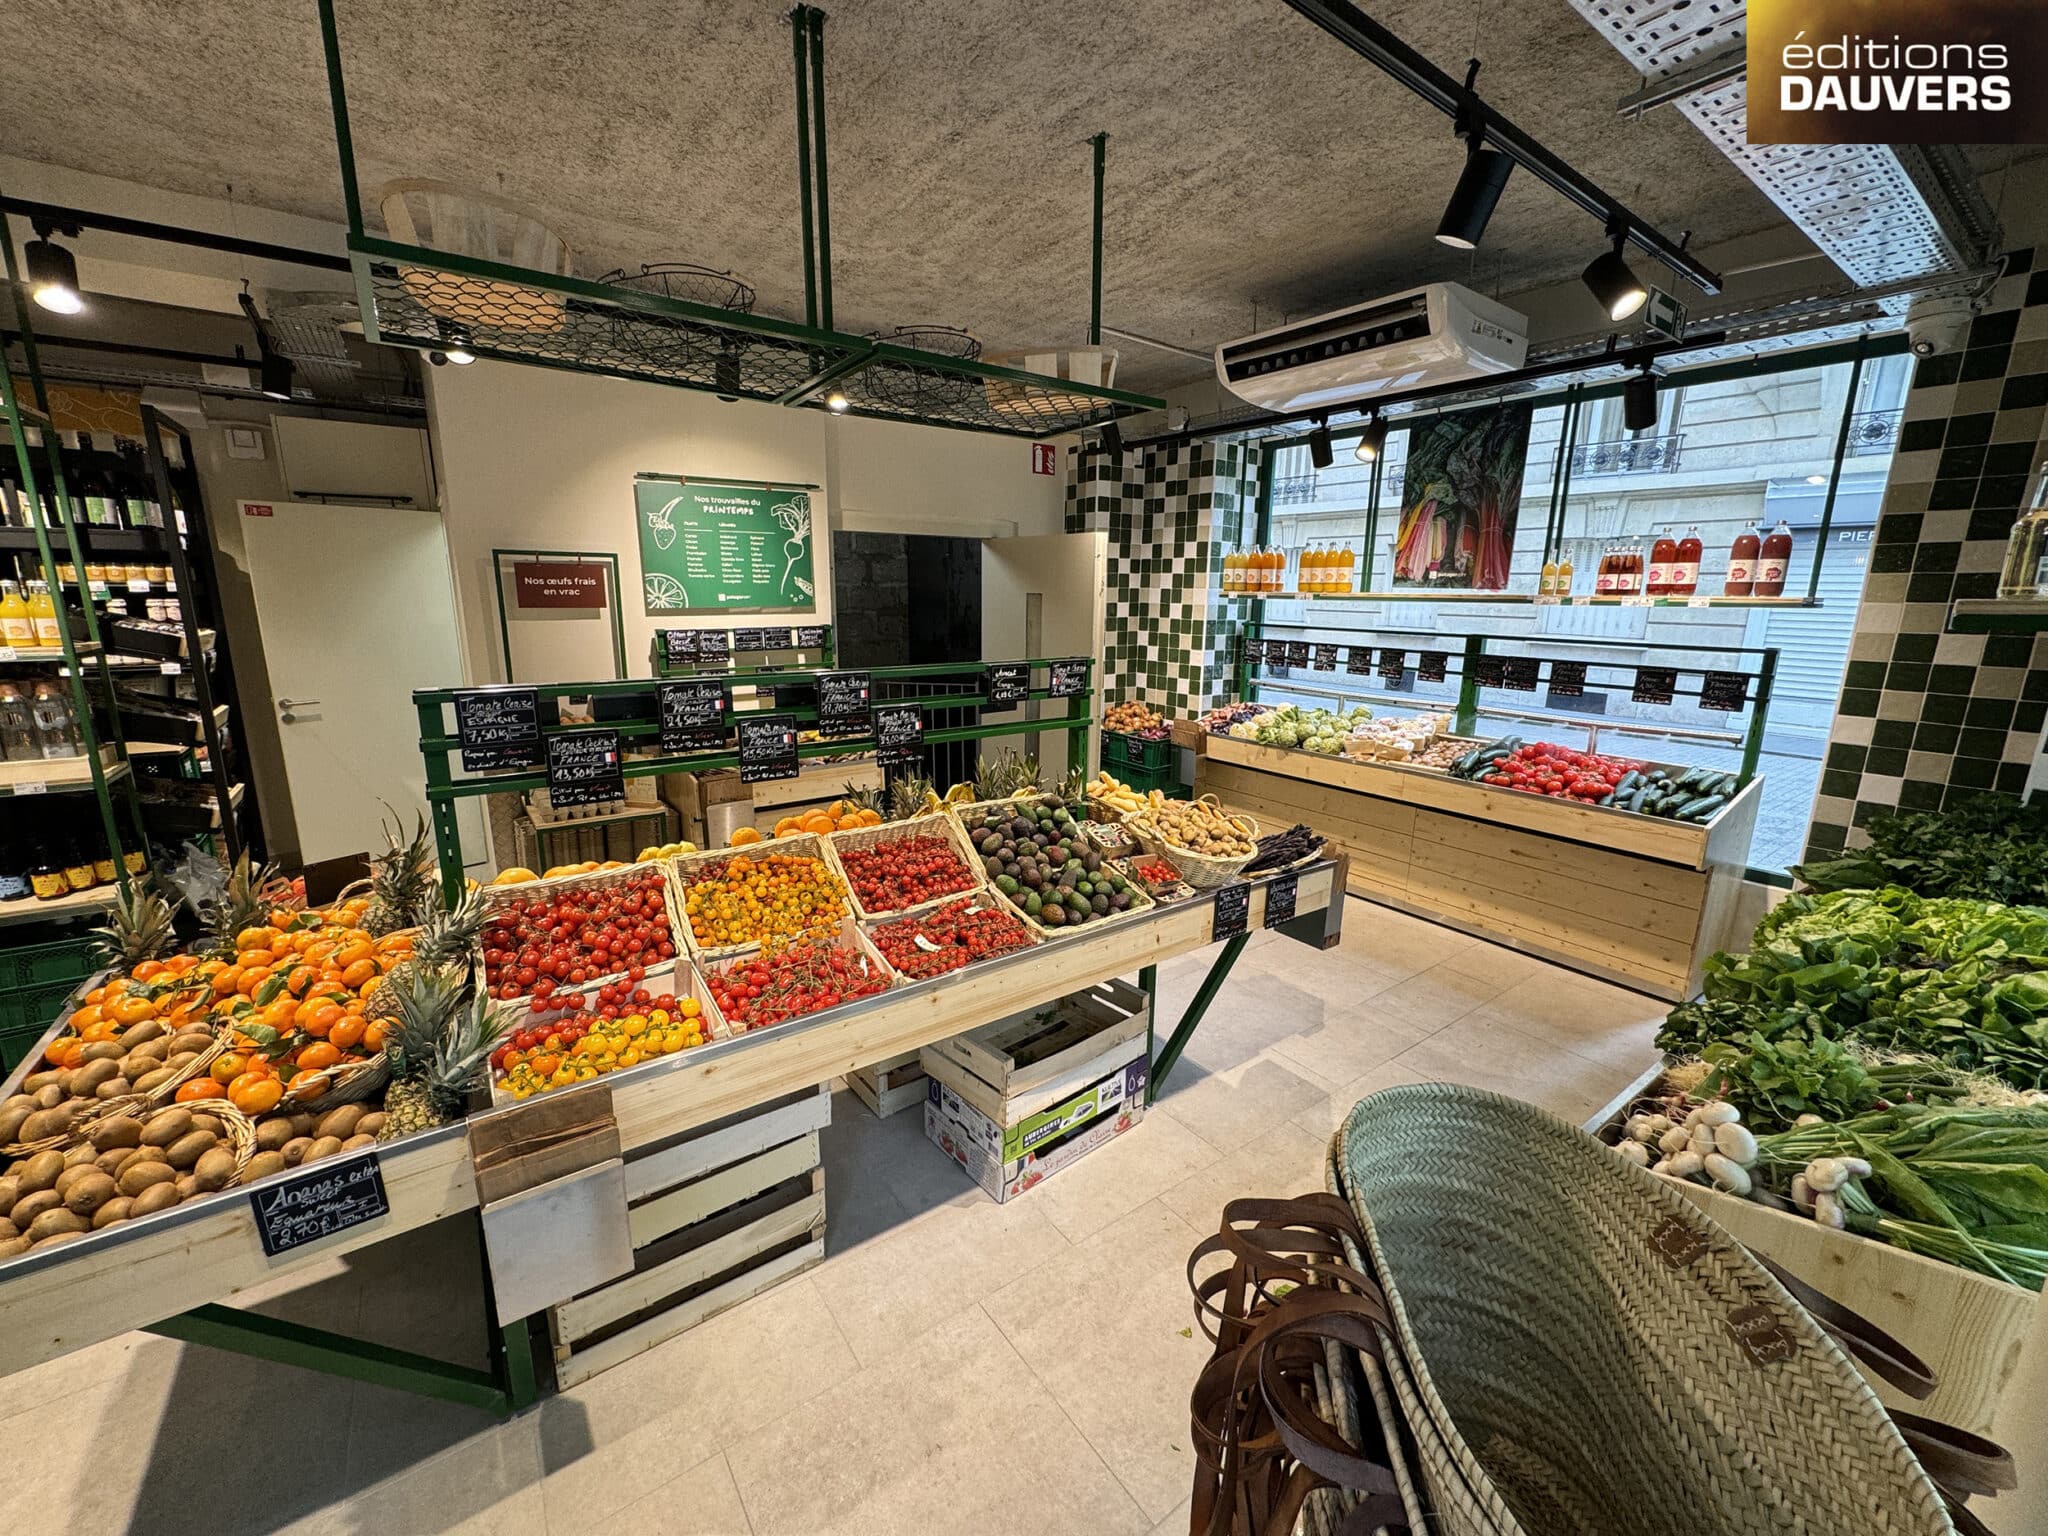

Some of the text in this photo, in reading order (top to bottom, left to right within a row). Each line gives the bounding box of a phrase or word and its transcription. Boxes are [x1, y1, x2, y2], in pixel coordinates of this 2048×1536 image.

[694, 495, 761, 506] Nos trouvailles du
[703, 505, 754, 515] PRINTEMPS
[524, 577, 597, 585] Nos œufs frais
[460, 696, 501, 713] Tomate
[467, 714, 519, 725] ESPAGNE
[548, 737, 583, 752] Tomate
[560, 753, 600, 766] FRANCE
[265, 1175, 345, 1213] Ananas
